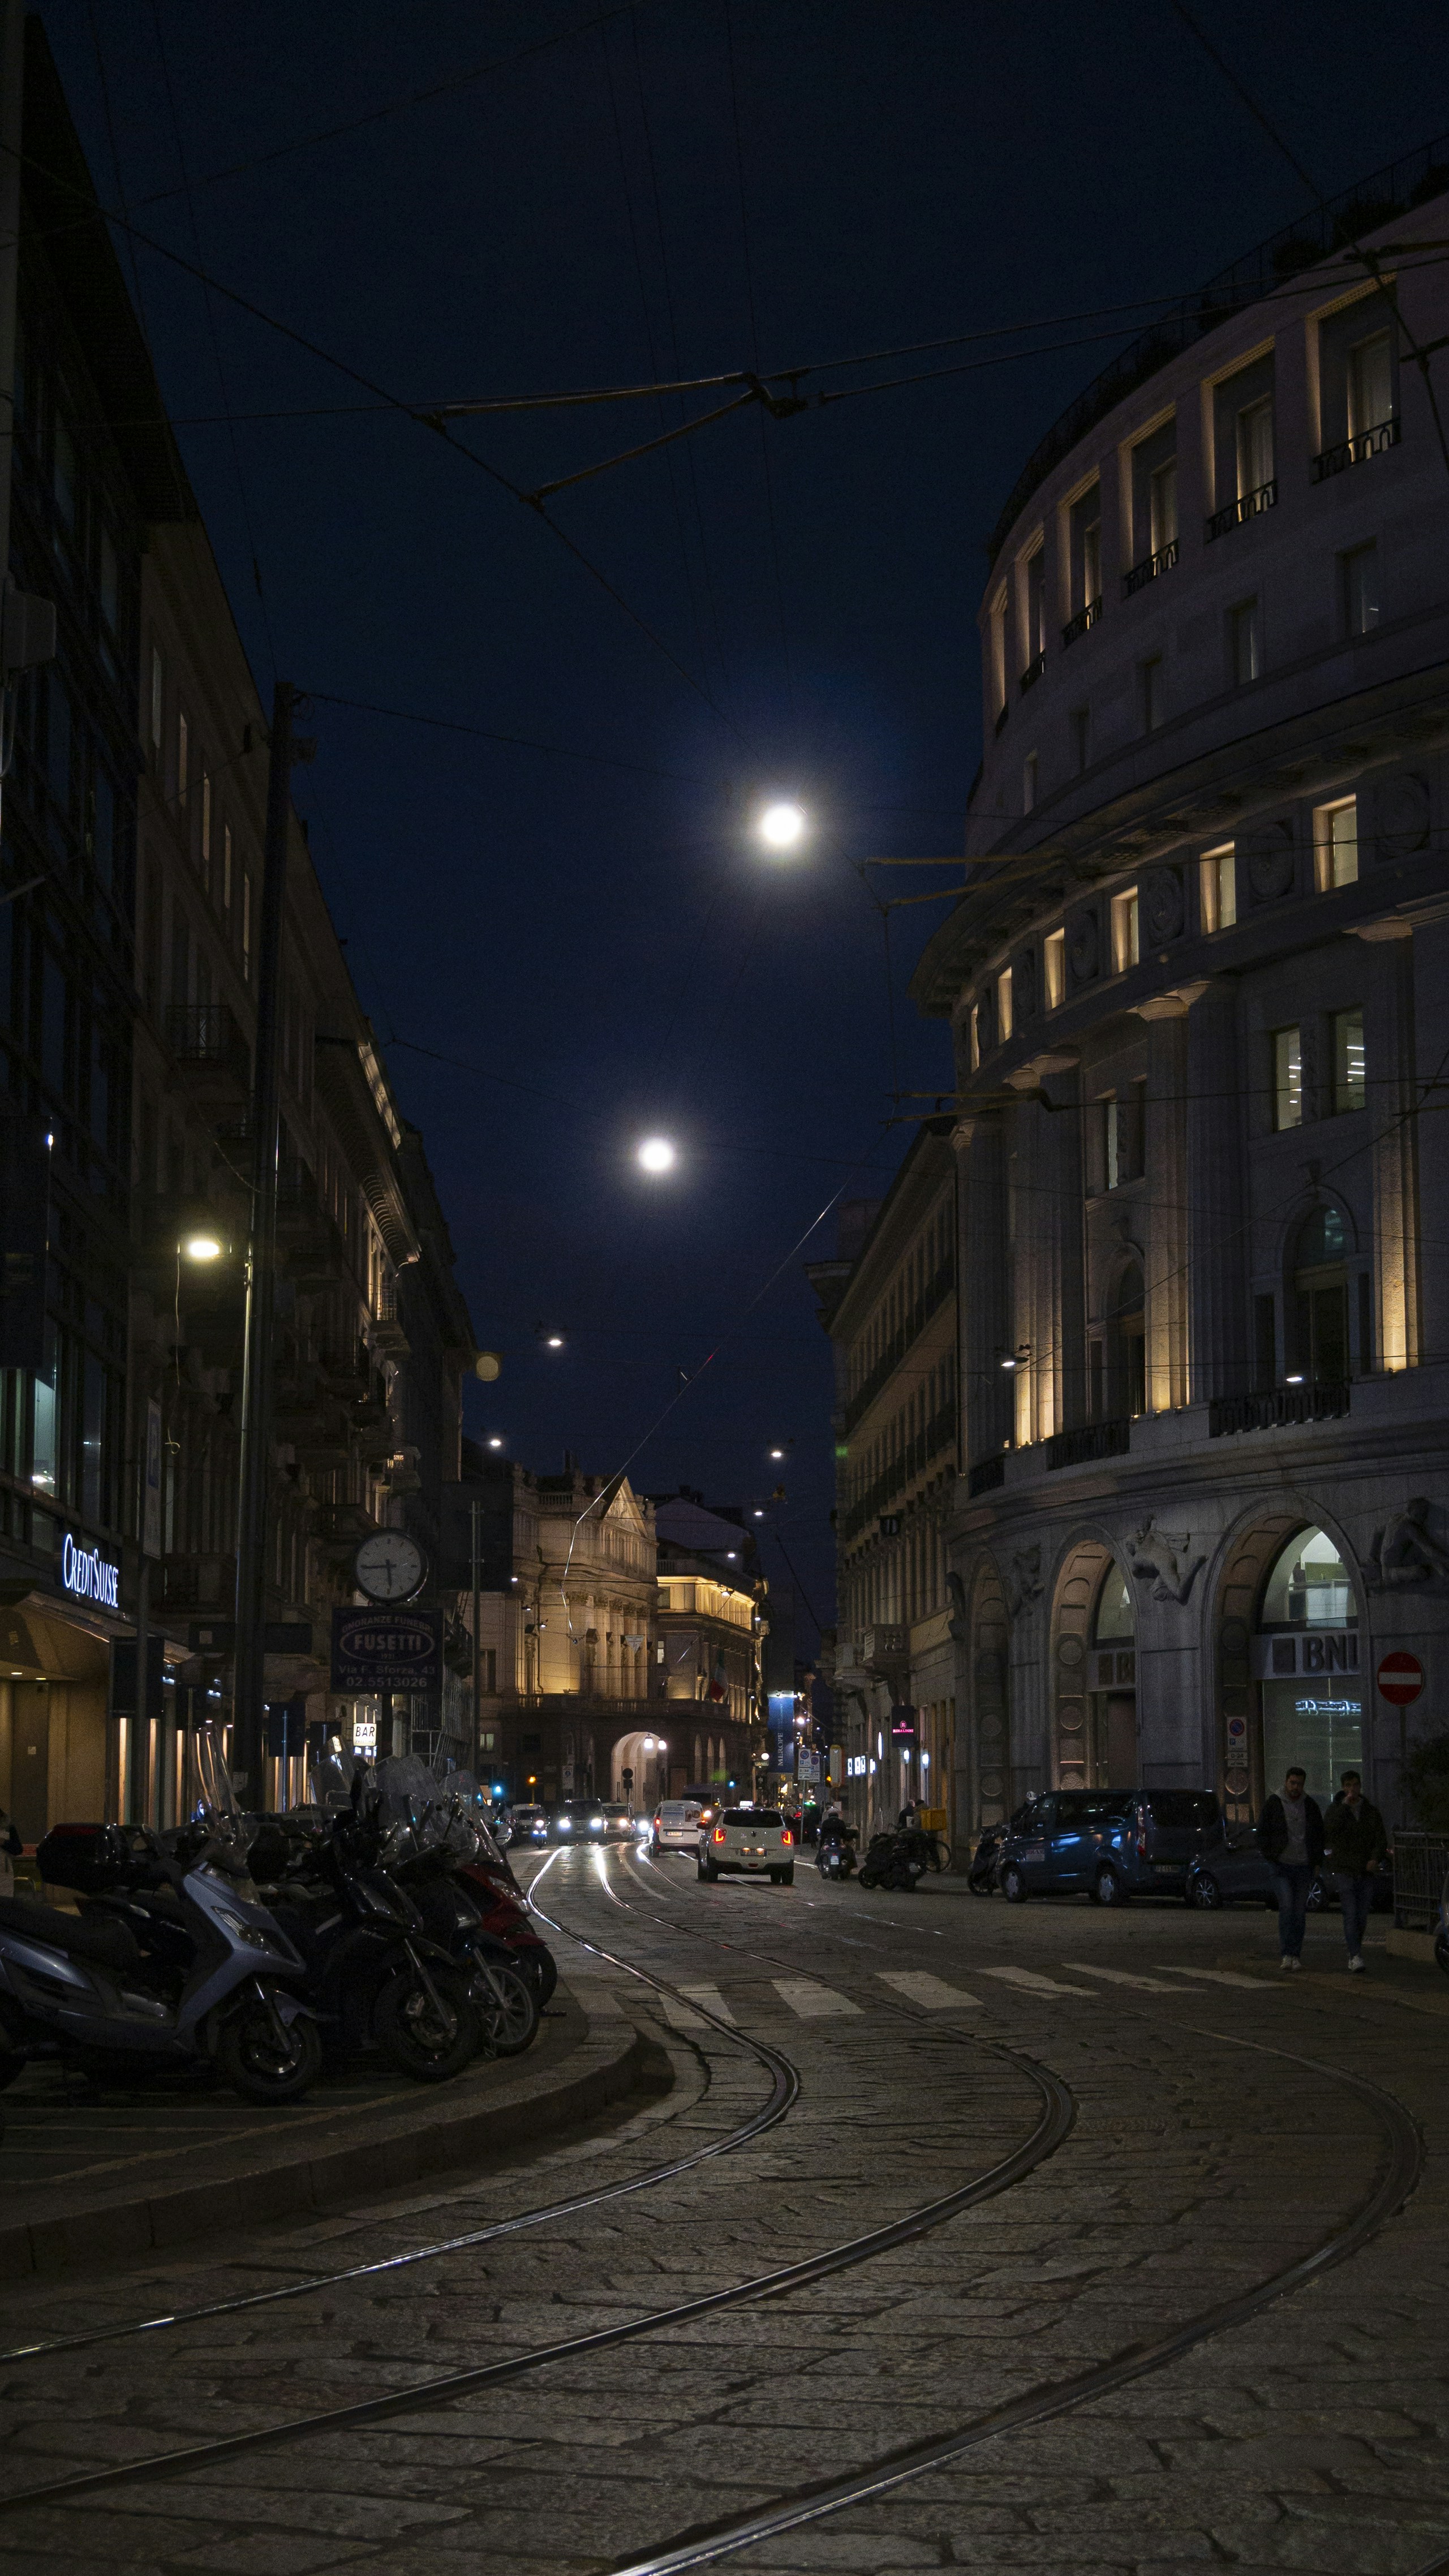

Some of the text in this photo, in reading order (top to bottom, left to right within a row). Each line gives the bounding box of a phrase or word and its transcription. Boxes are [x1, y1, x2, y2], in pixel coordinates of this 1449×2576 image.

[342, 1615, 393, 1633] ONORANZE
[354, 1634, 422, 1651] FUSETTI
[339, 1665, 356, 1674] Via
[421, 1665, 436, 1675] 43
[346, 1677, 428, 1687] 02.5513026
[355, 1727, 375, 1737] BAR
